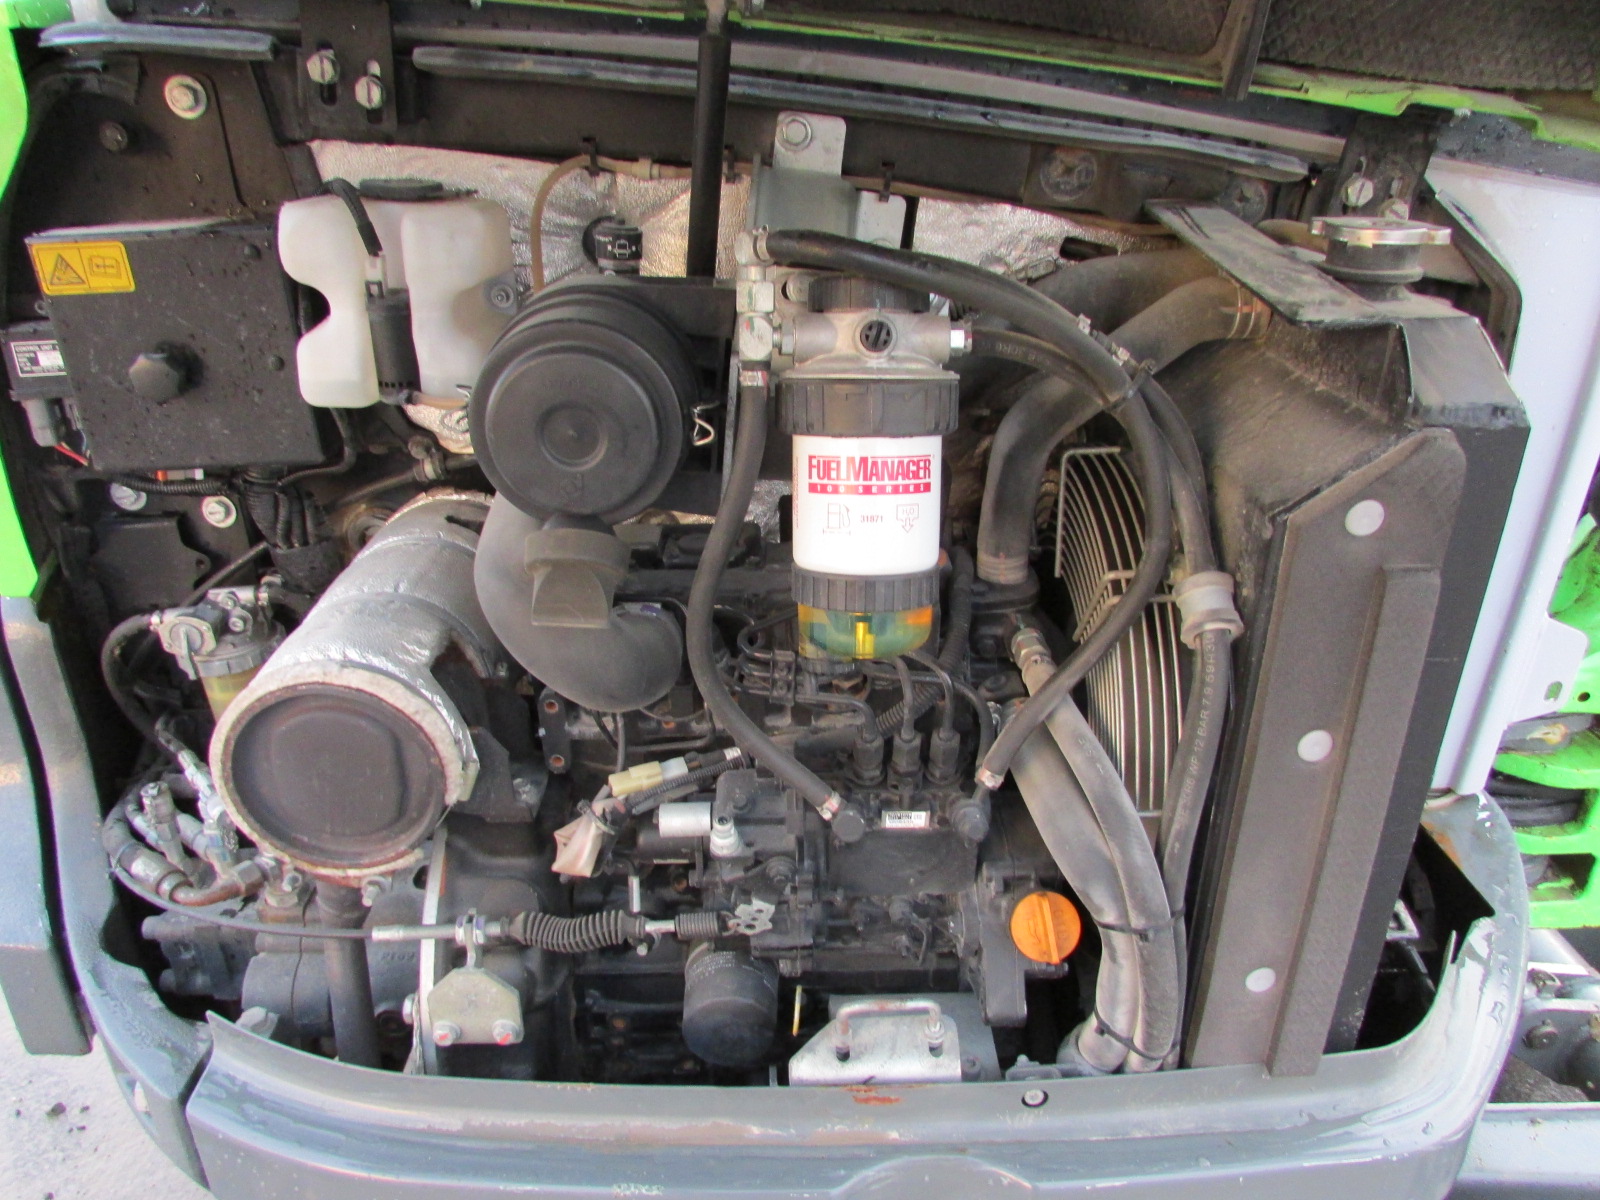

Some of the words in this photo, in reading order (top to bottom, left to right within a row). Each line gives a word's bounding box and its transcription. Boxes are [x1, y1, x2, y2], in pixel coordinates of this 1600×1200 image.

[817, 485, 845, 493] 100
[858, 485, 924, 493] SERIES
[1197, 710, 1210, 737] BAR
